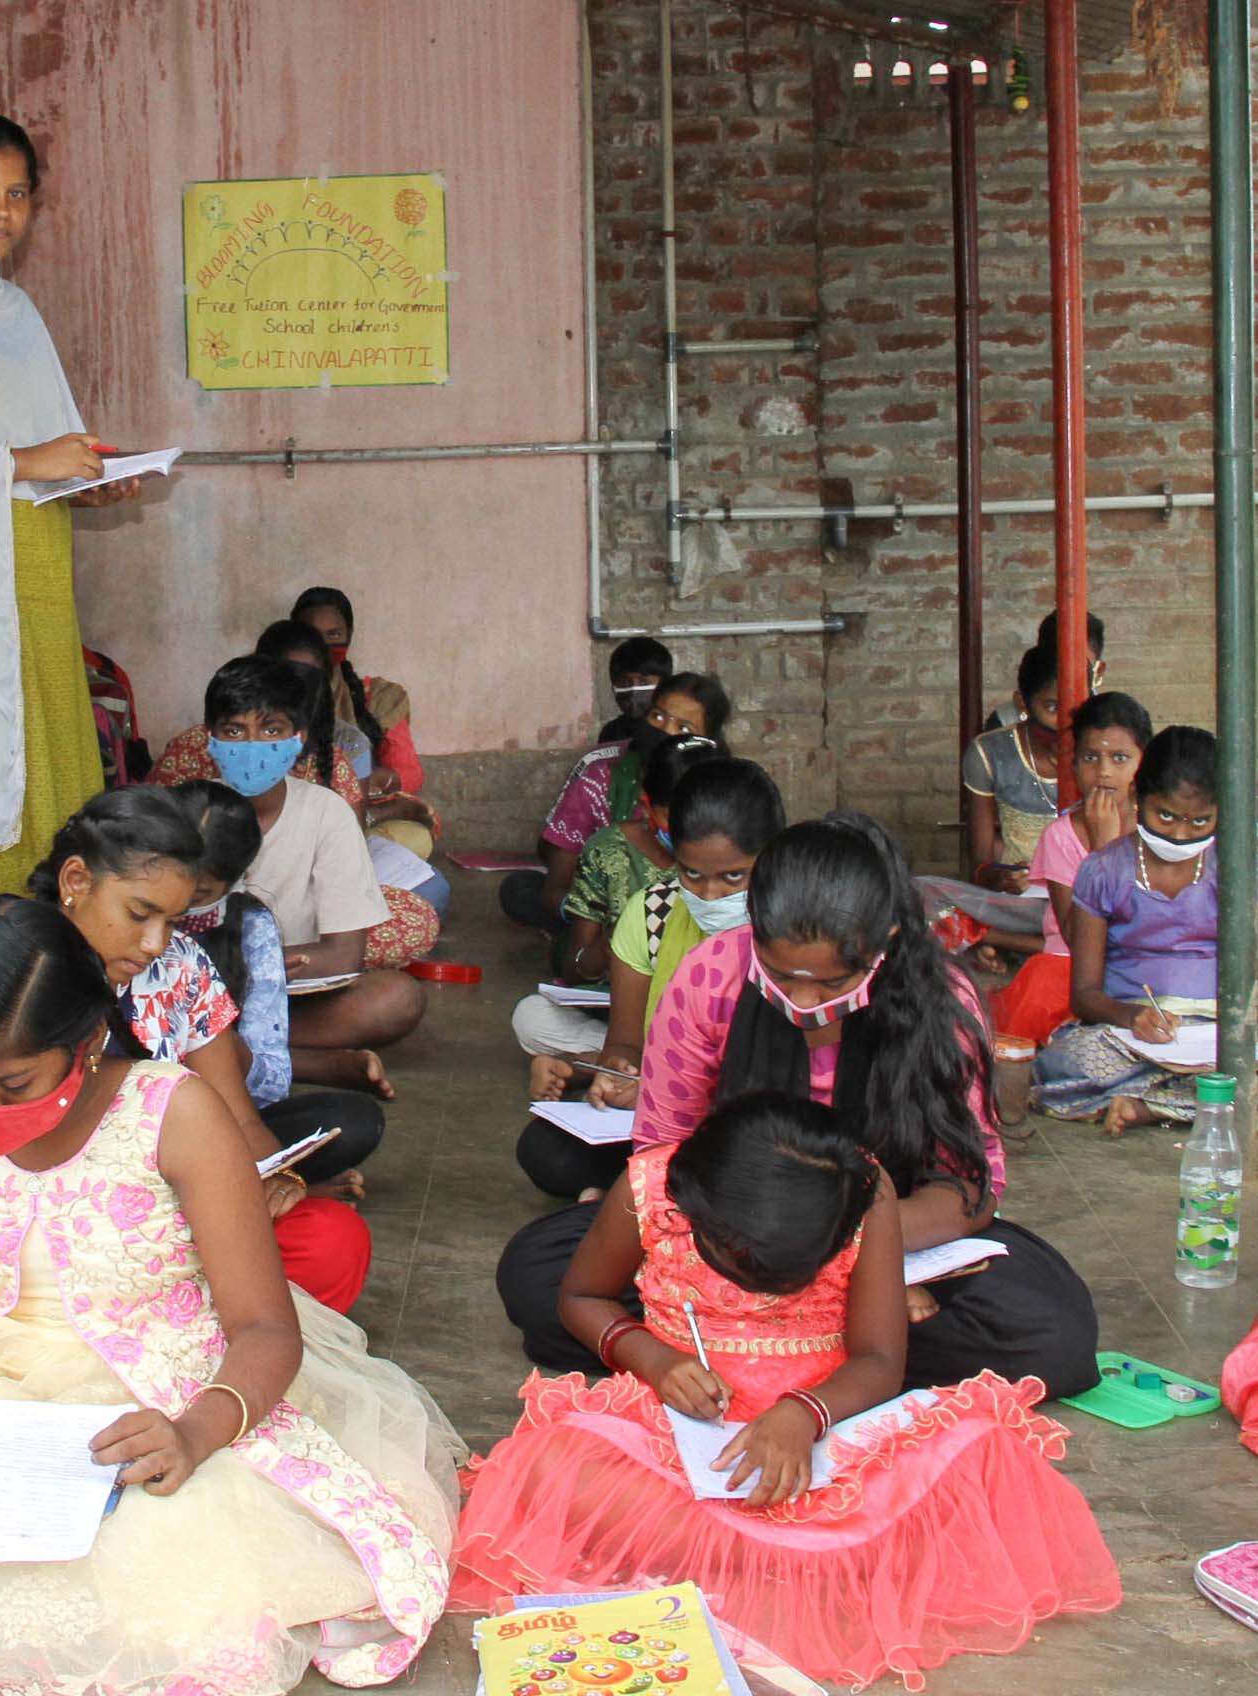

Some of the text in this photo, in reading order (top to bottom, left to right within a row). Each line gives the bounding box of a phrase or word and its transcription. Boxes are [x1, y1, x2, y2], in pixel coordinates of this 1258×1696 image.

[197, 192, 429, 299] BLOOMING FOUNDATION
[196, 297, 237, 314] Free
[354, 298, 374, 311] for
[263, 318, 315, 334] School
[242, 347, 434, 369] CHINNALAPATTI
[656, 1596, 687, 1622] 2
[497, 1611, 578, 1641] தமிழ்
